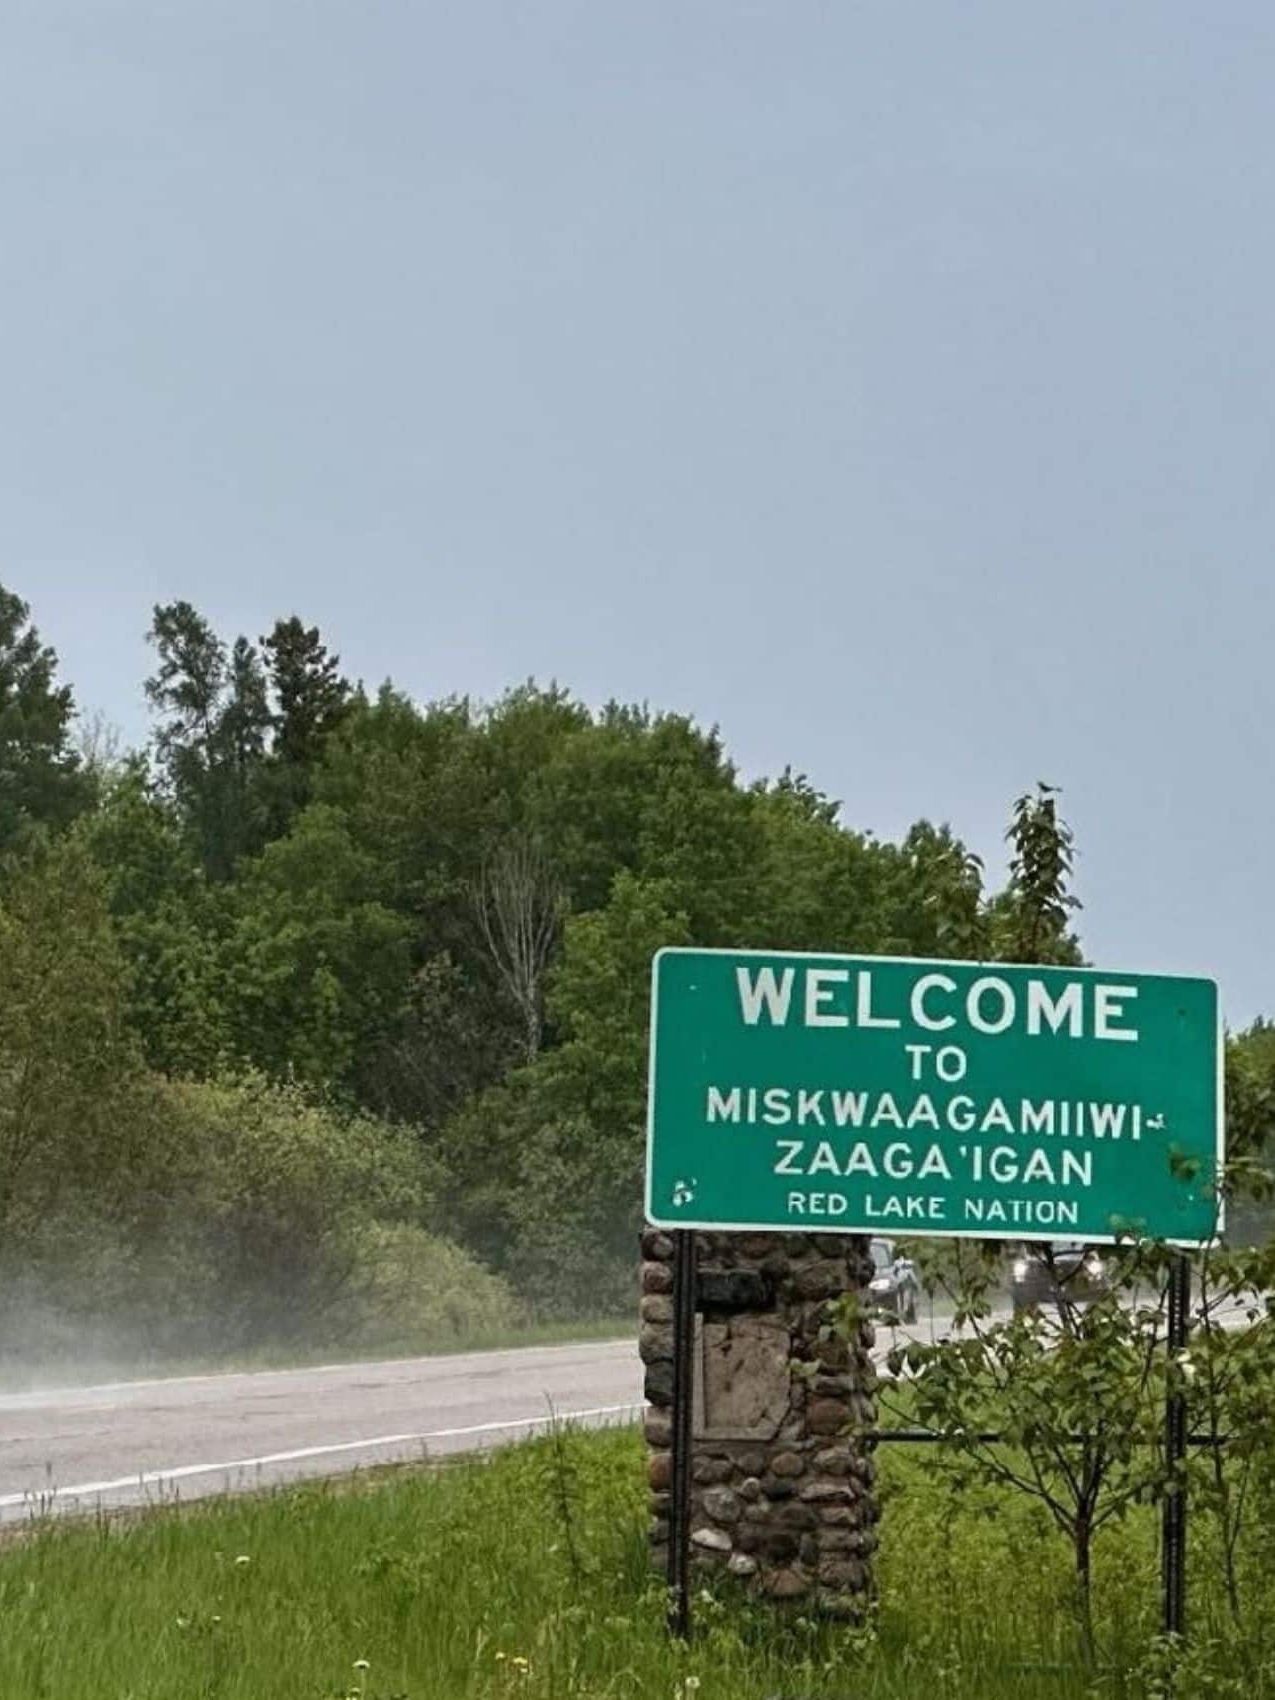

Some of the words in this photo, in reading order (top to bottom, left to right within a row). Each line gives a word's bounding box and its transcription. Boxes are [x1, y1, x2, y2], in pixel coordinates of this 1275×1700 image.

[735, 966, 1139, 1042] WELCOME
[904, 1044, 968, 1083] TO
[773, 1140, 1093, 1187] ZAAGA'IGAN
[787, 1191, 848, 1216] RED
[865, 1193, 946, 1219] LAKE
[964, 1198, 1079, 1225] NATION
